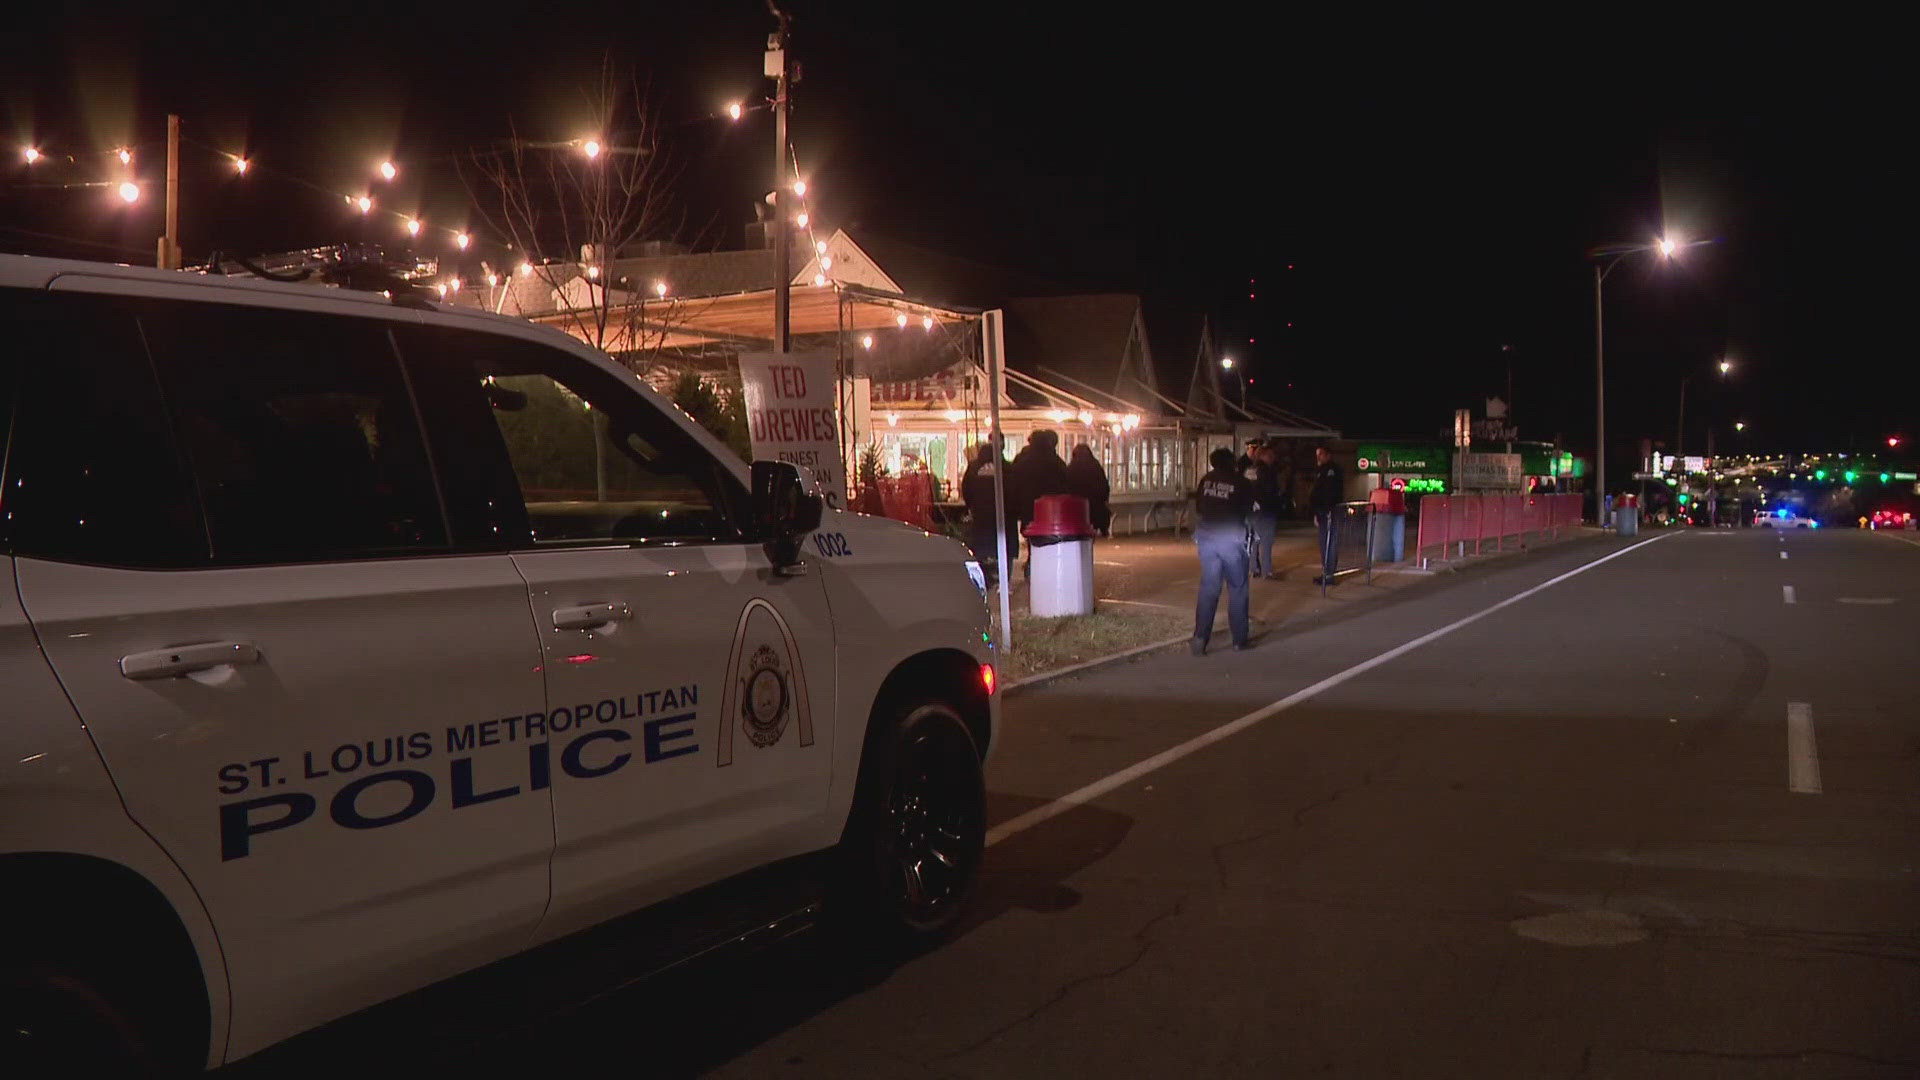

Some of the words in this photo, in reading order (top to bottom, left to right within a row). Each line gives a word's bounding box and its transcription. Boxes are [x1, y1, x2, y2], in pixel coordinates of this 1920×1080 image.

[768, 365, 807, 399] TED
[752, 407, 835, 443] DREWES
[779, 450, 819, 465] FINEST
[813, 531, 852, 558] 1002
[218, 757, 287, 795] ST.
[303, 732, 433, 780] LOUIS
[446, 684, 699, 753] METROPOLITAN
[219, 711, 700, 862] POLICE
